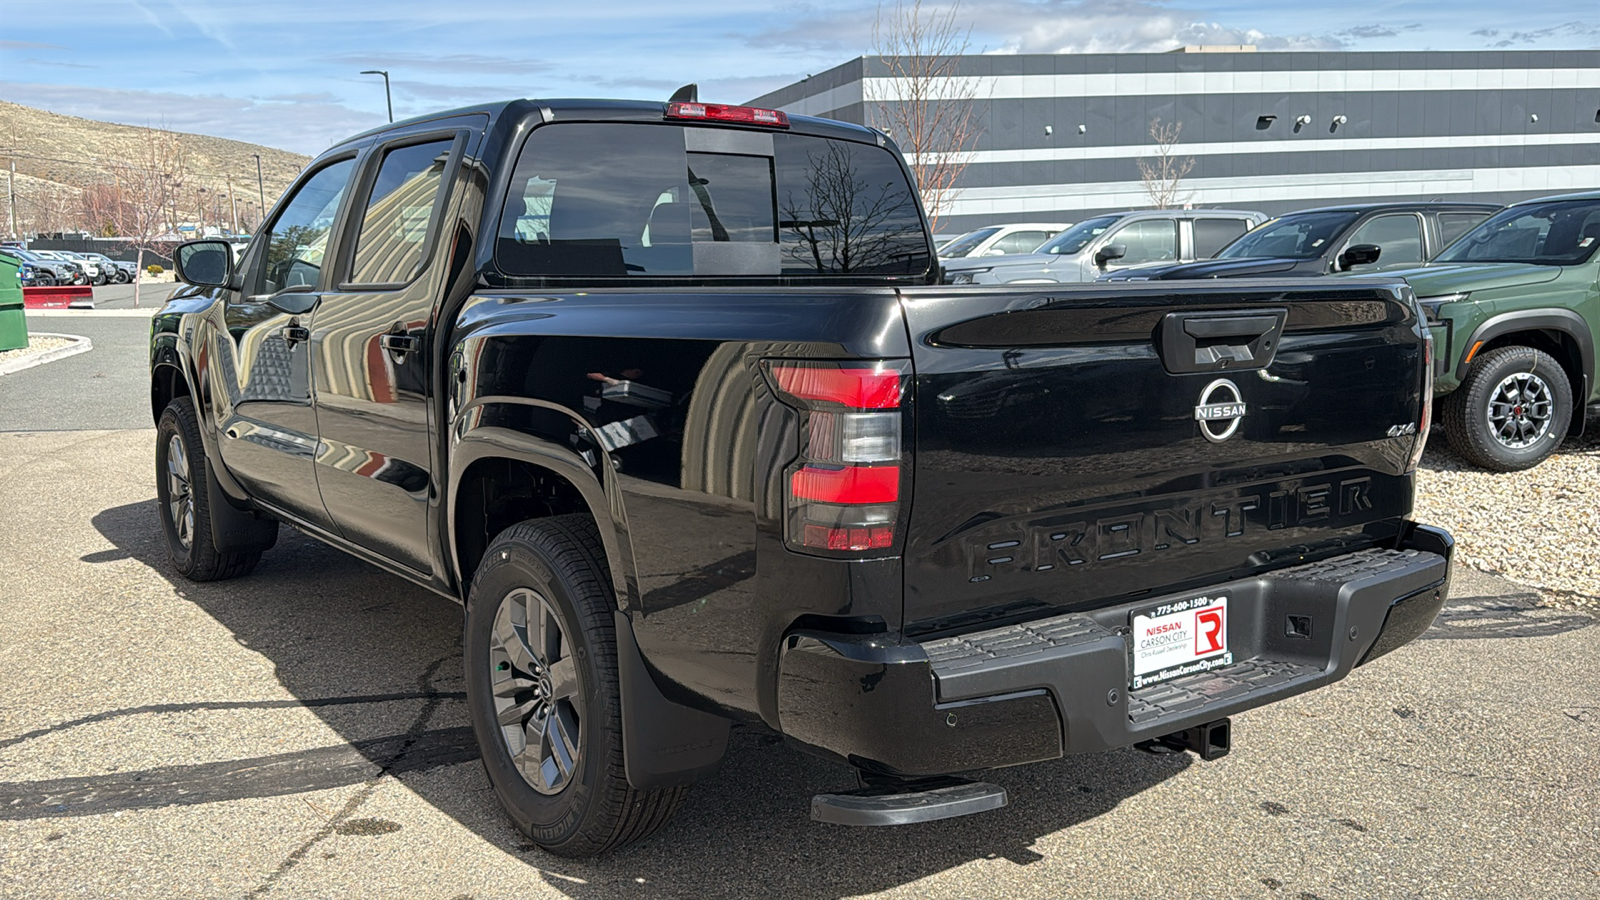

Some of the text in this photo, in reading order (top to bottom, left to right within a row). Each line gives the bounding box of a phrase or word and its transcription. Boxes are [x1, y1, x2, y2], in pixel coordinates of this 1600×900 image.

[1197, 404, 1246, 419] NISSAN
[967, 475, 1373, 583] FRONTIER
[476, 548, 511, 586] MICHELN
[1156, 596, 1208, 616] 775-600-1500
[1140, 630, 1188, 649] CARSON CITY
[1146, 621, 1182, 637] NISSAN
[1198, 612, 1221, 650] R
[1141, 643, 1188, 659] Chris Russell Dealership
[1141, 658, 1224, 685] www.NissanCarsonCity.com
[533, 811, 575, 840] MICHELIN
